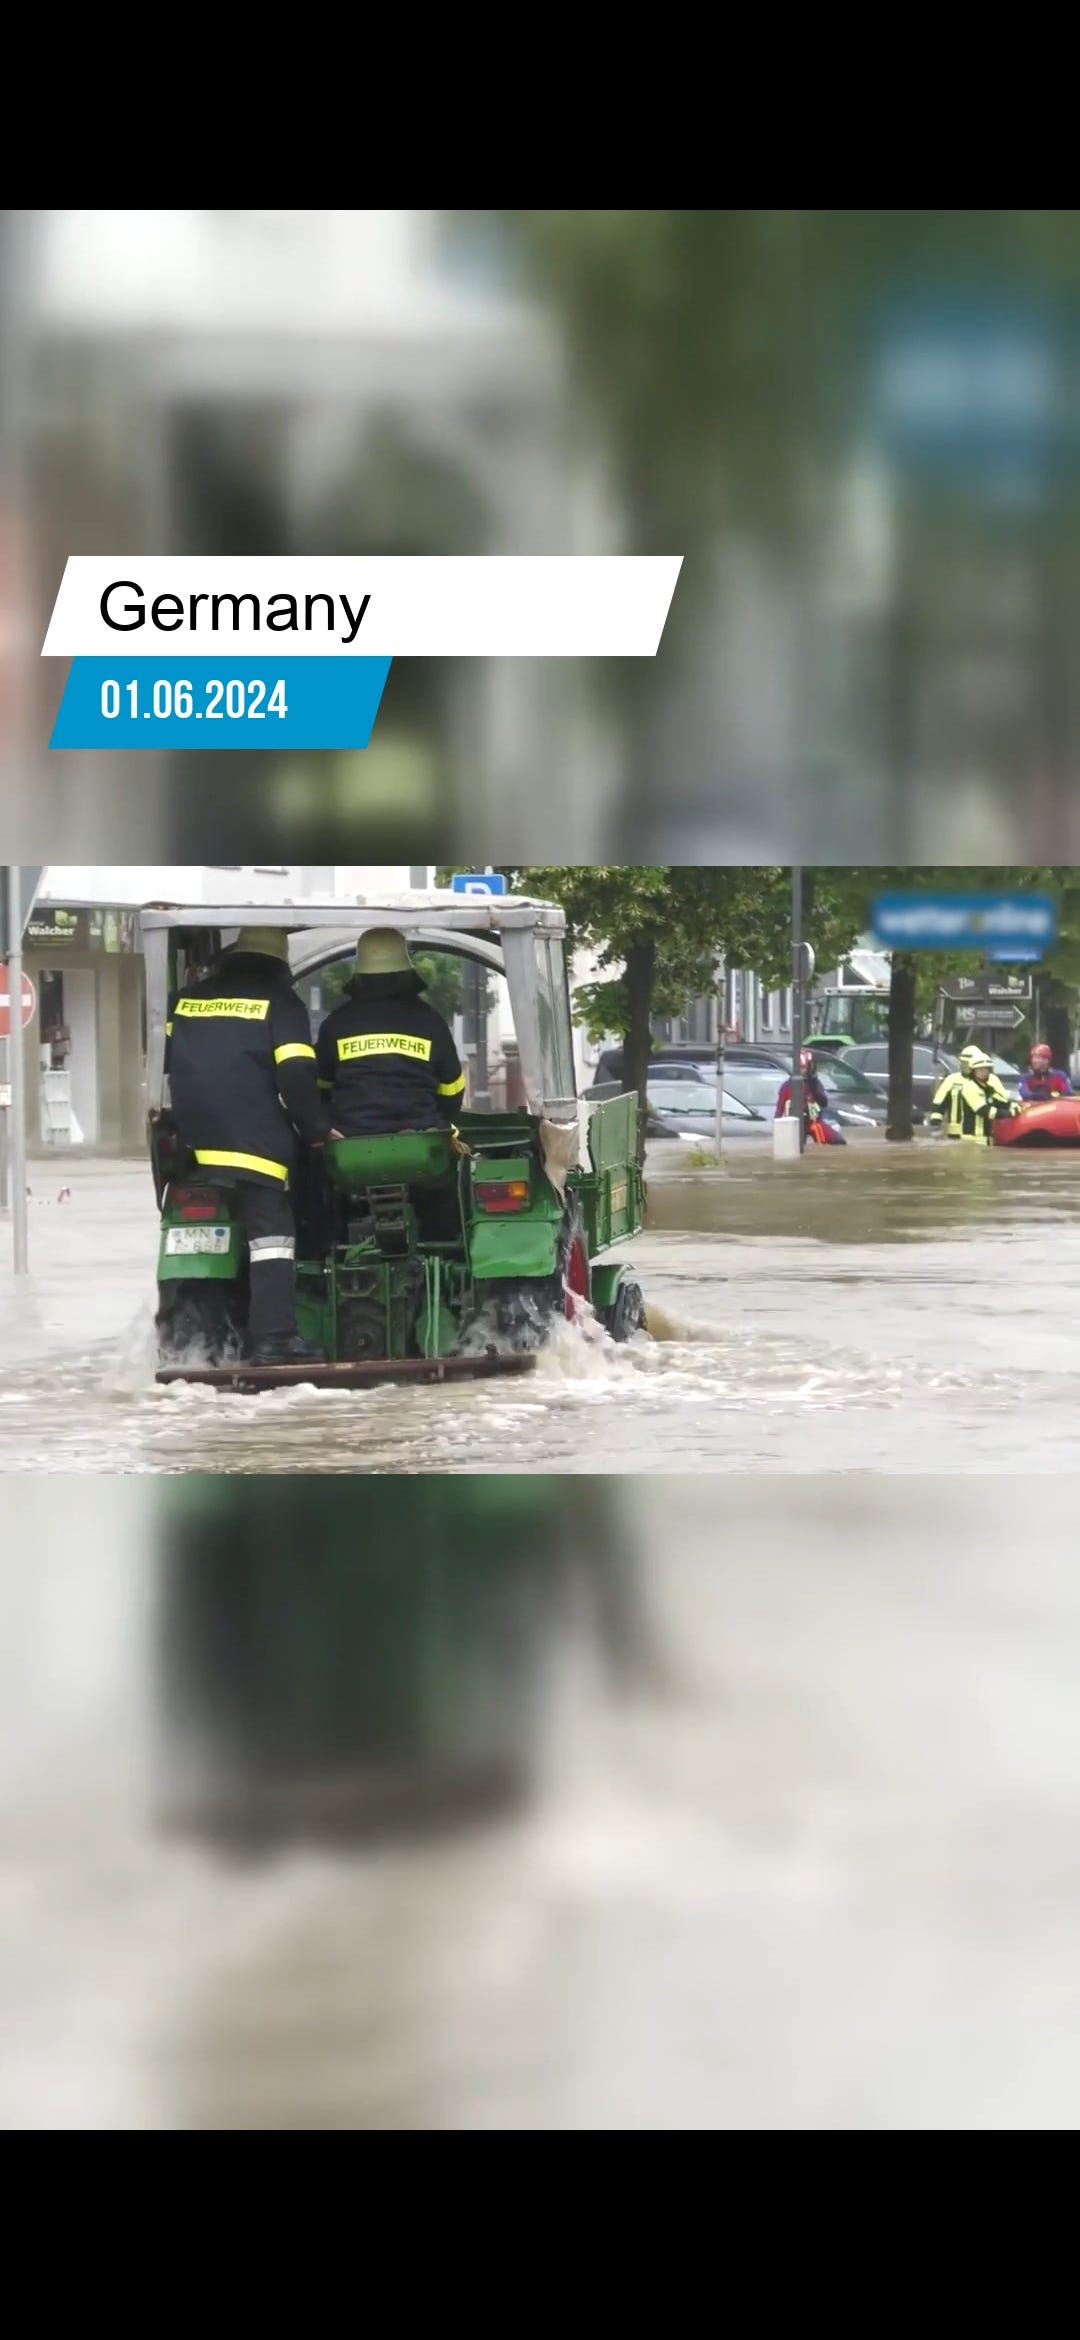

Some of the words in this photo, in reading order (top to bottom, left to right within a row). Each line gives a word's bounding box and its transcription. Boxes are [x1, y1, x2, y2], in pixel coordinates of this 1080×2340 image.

[28, 926, 75, 936] Walcher
[180, 1001, 262, 1014] FEUERWEHR
[342, 1036, 427, 1055] FEUERWEHR
